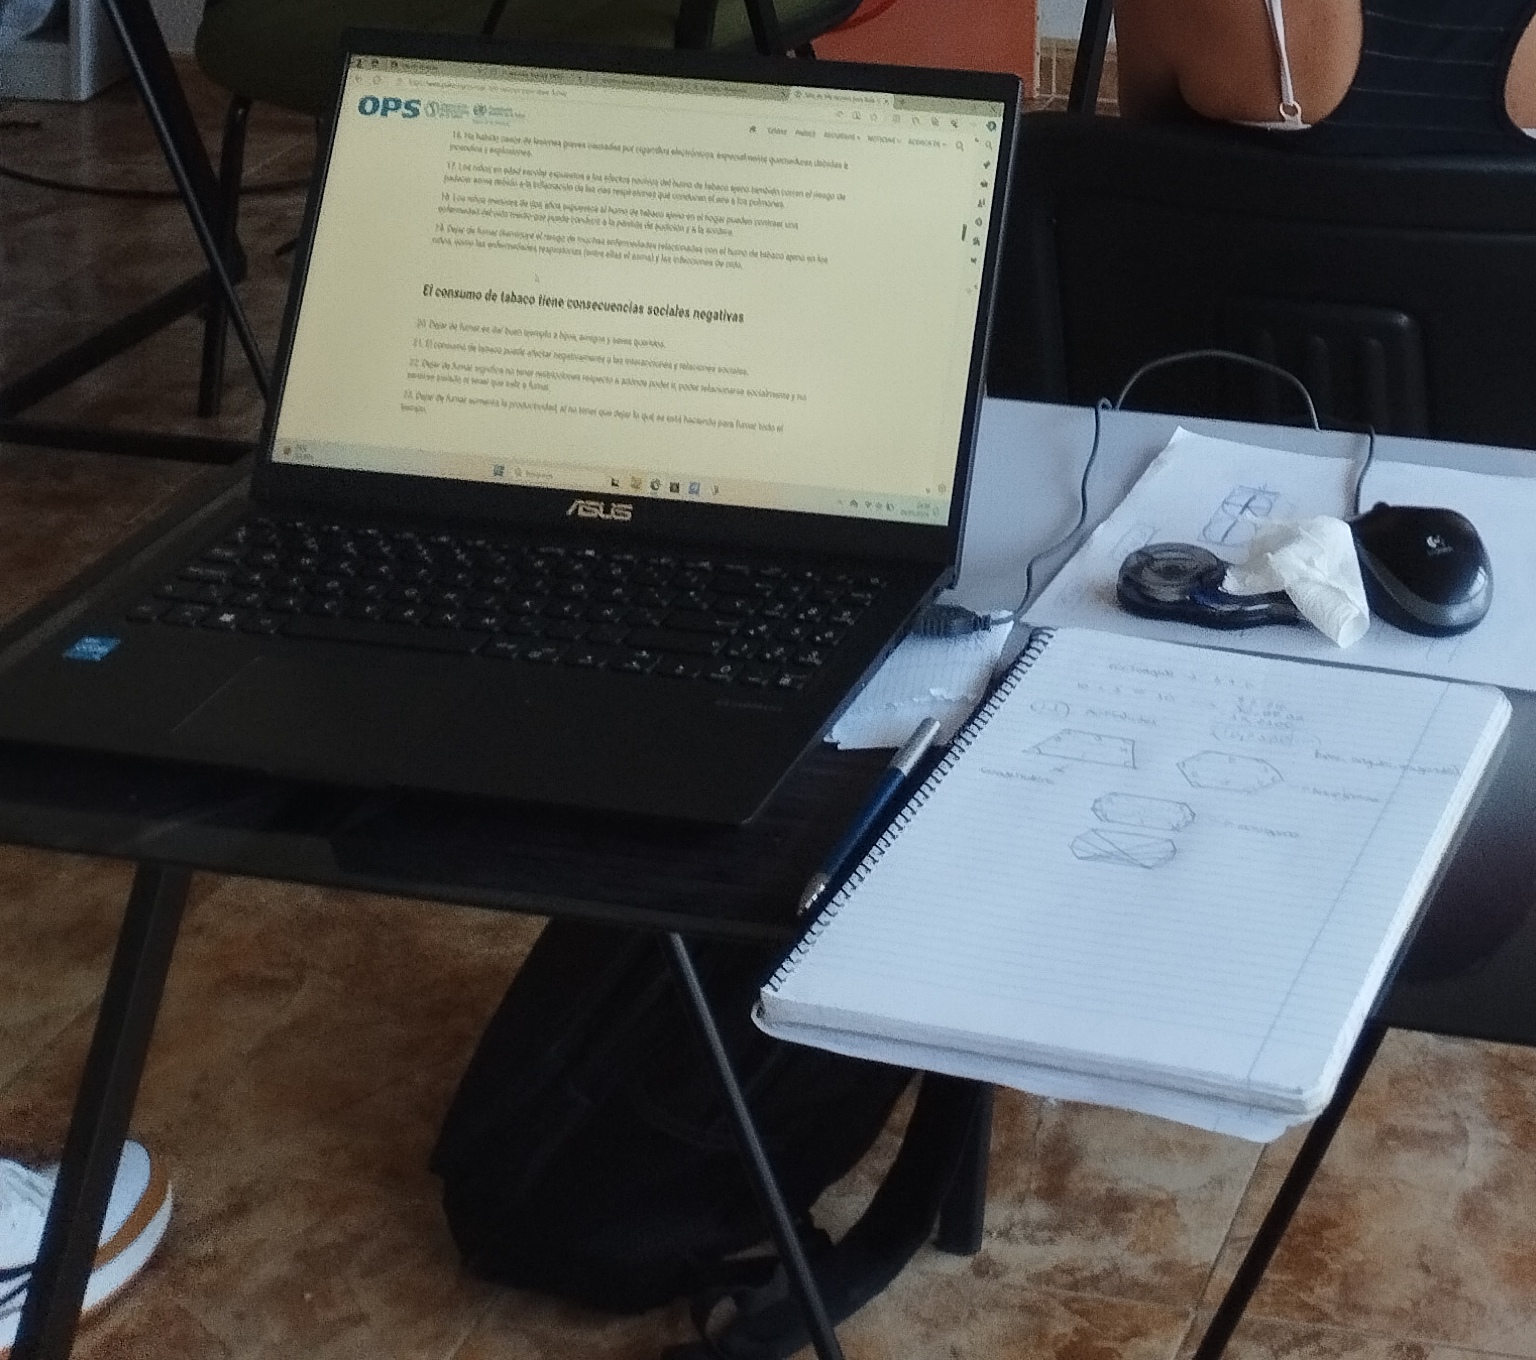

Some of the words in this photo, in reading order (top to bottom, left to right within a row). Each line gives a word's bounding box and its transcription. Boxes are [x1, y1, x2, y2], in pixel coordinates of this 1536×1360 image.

[358, 95, 421, 119] OPS
[422, 283, 434, 297] El
[435, 287, 482, 301] consumo
[484, 289, 498, 302] de
[500, 290, 535, 306] tabaco
[538, 294, 564, 309] tiene
[566, 296, 644, 315] consecuencias
[647, 304, 690, 319] sociales
[693, 307, 744, 323] negativas
[566, 498, 634, 521] ASUS
